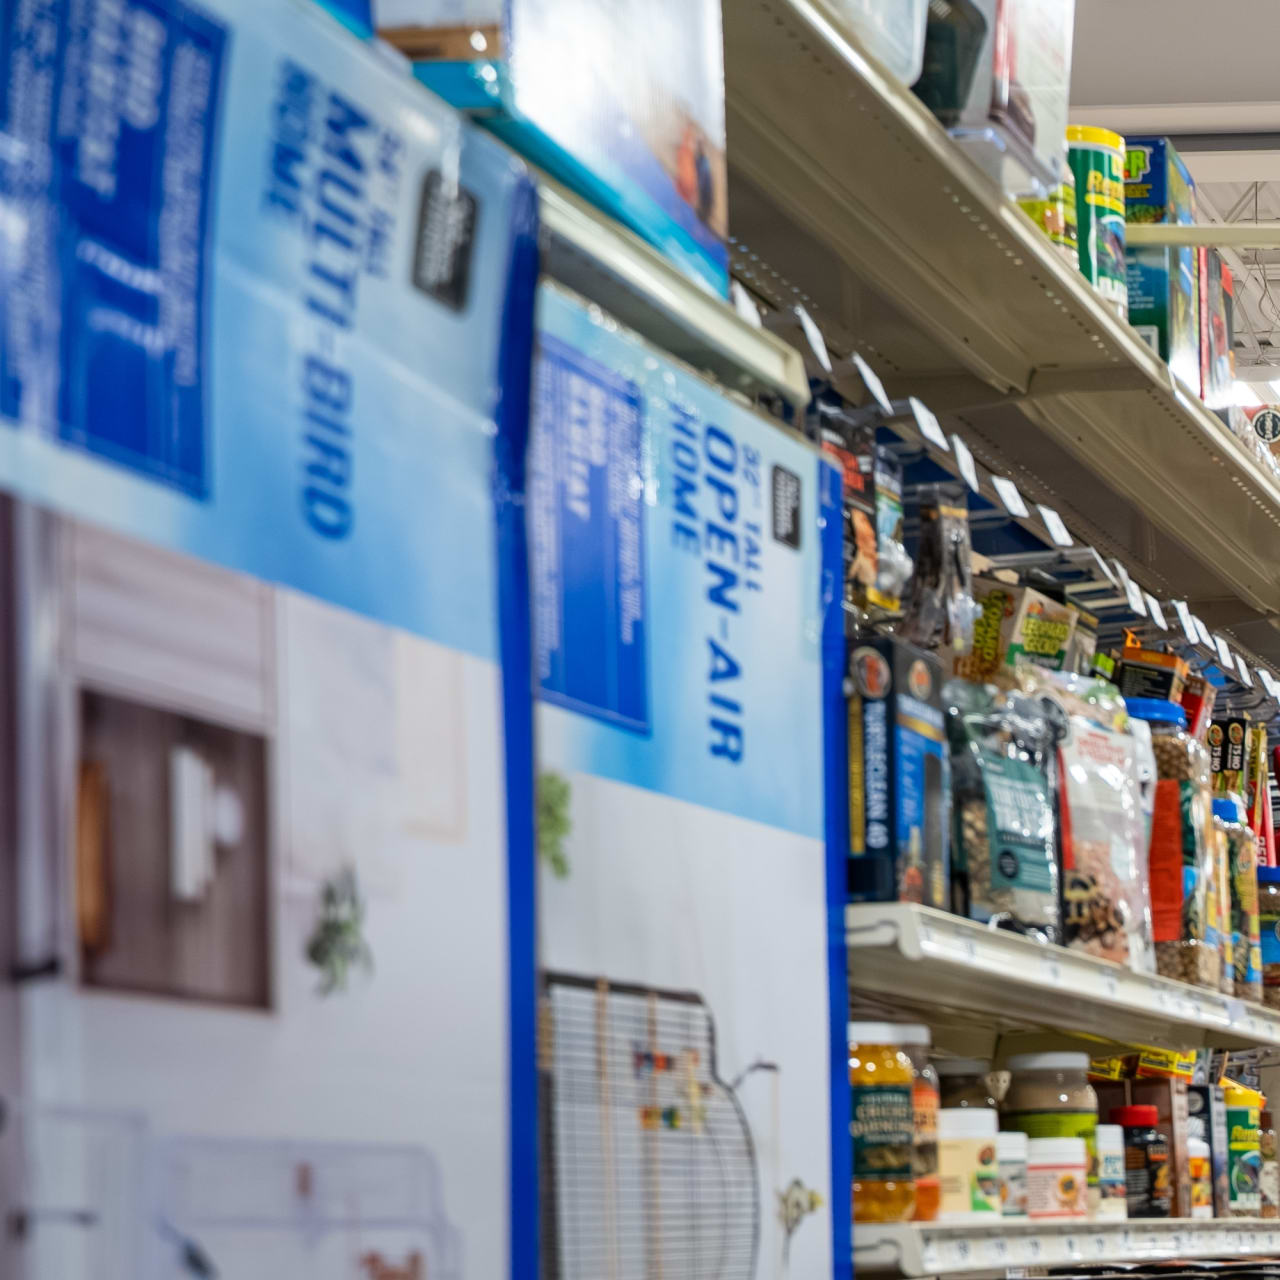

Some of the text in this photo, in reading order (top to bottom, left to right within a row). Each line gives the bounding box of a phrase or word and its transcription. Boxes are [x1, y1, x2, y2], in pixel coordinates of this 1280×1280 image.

[302, 90, 377, 543] MULTI-BIRD
[667, 402, 702, 556] HOME
[702, 421, 747, 766] OPEN-AIR
